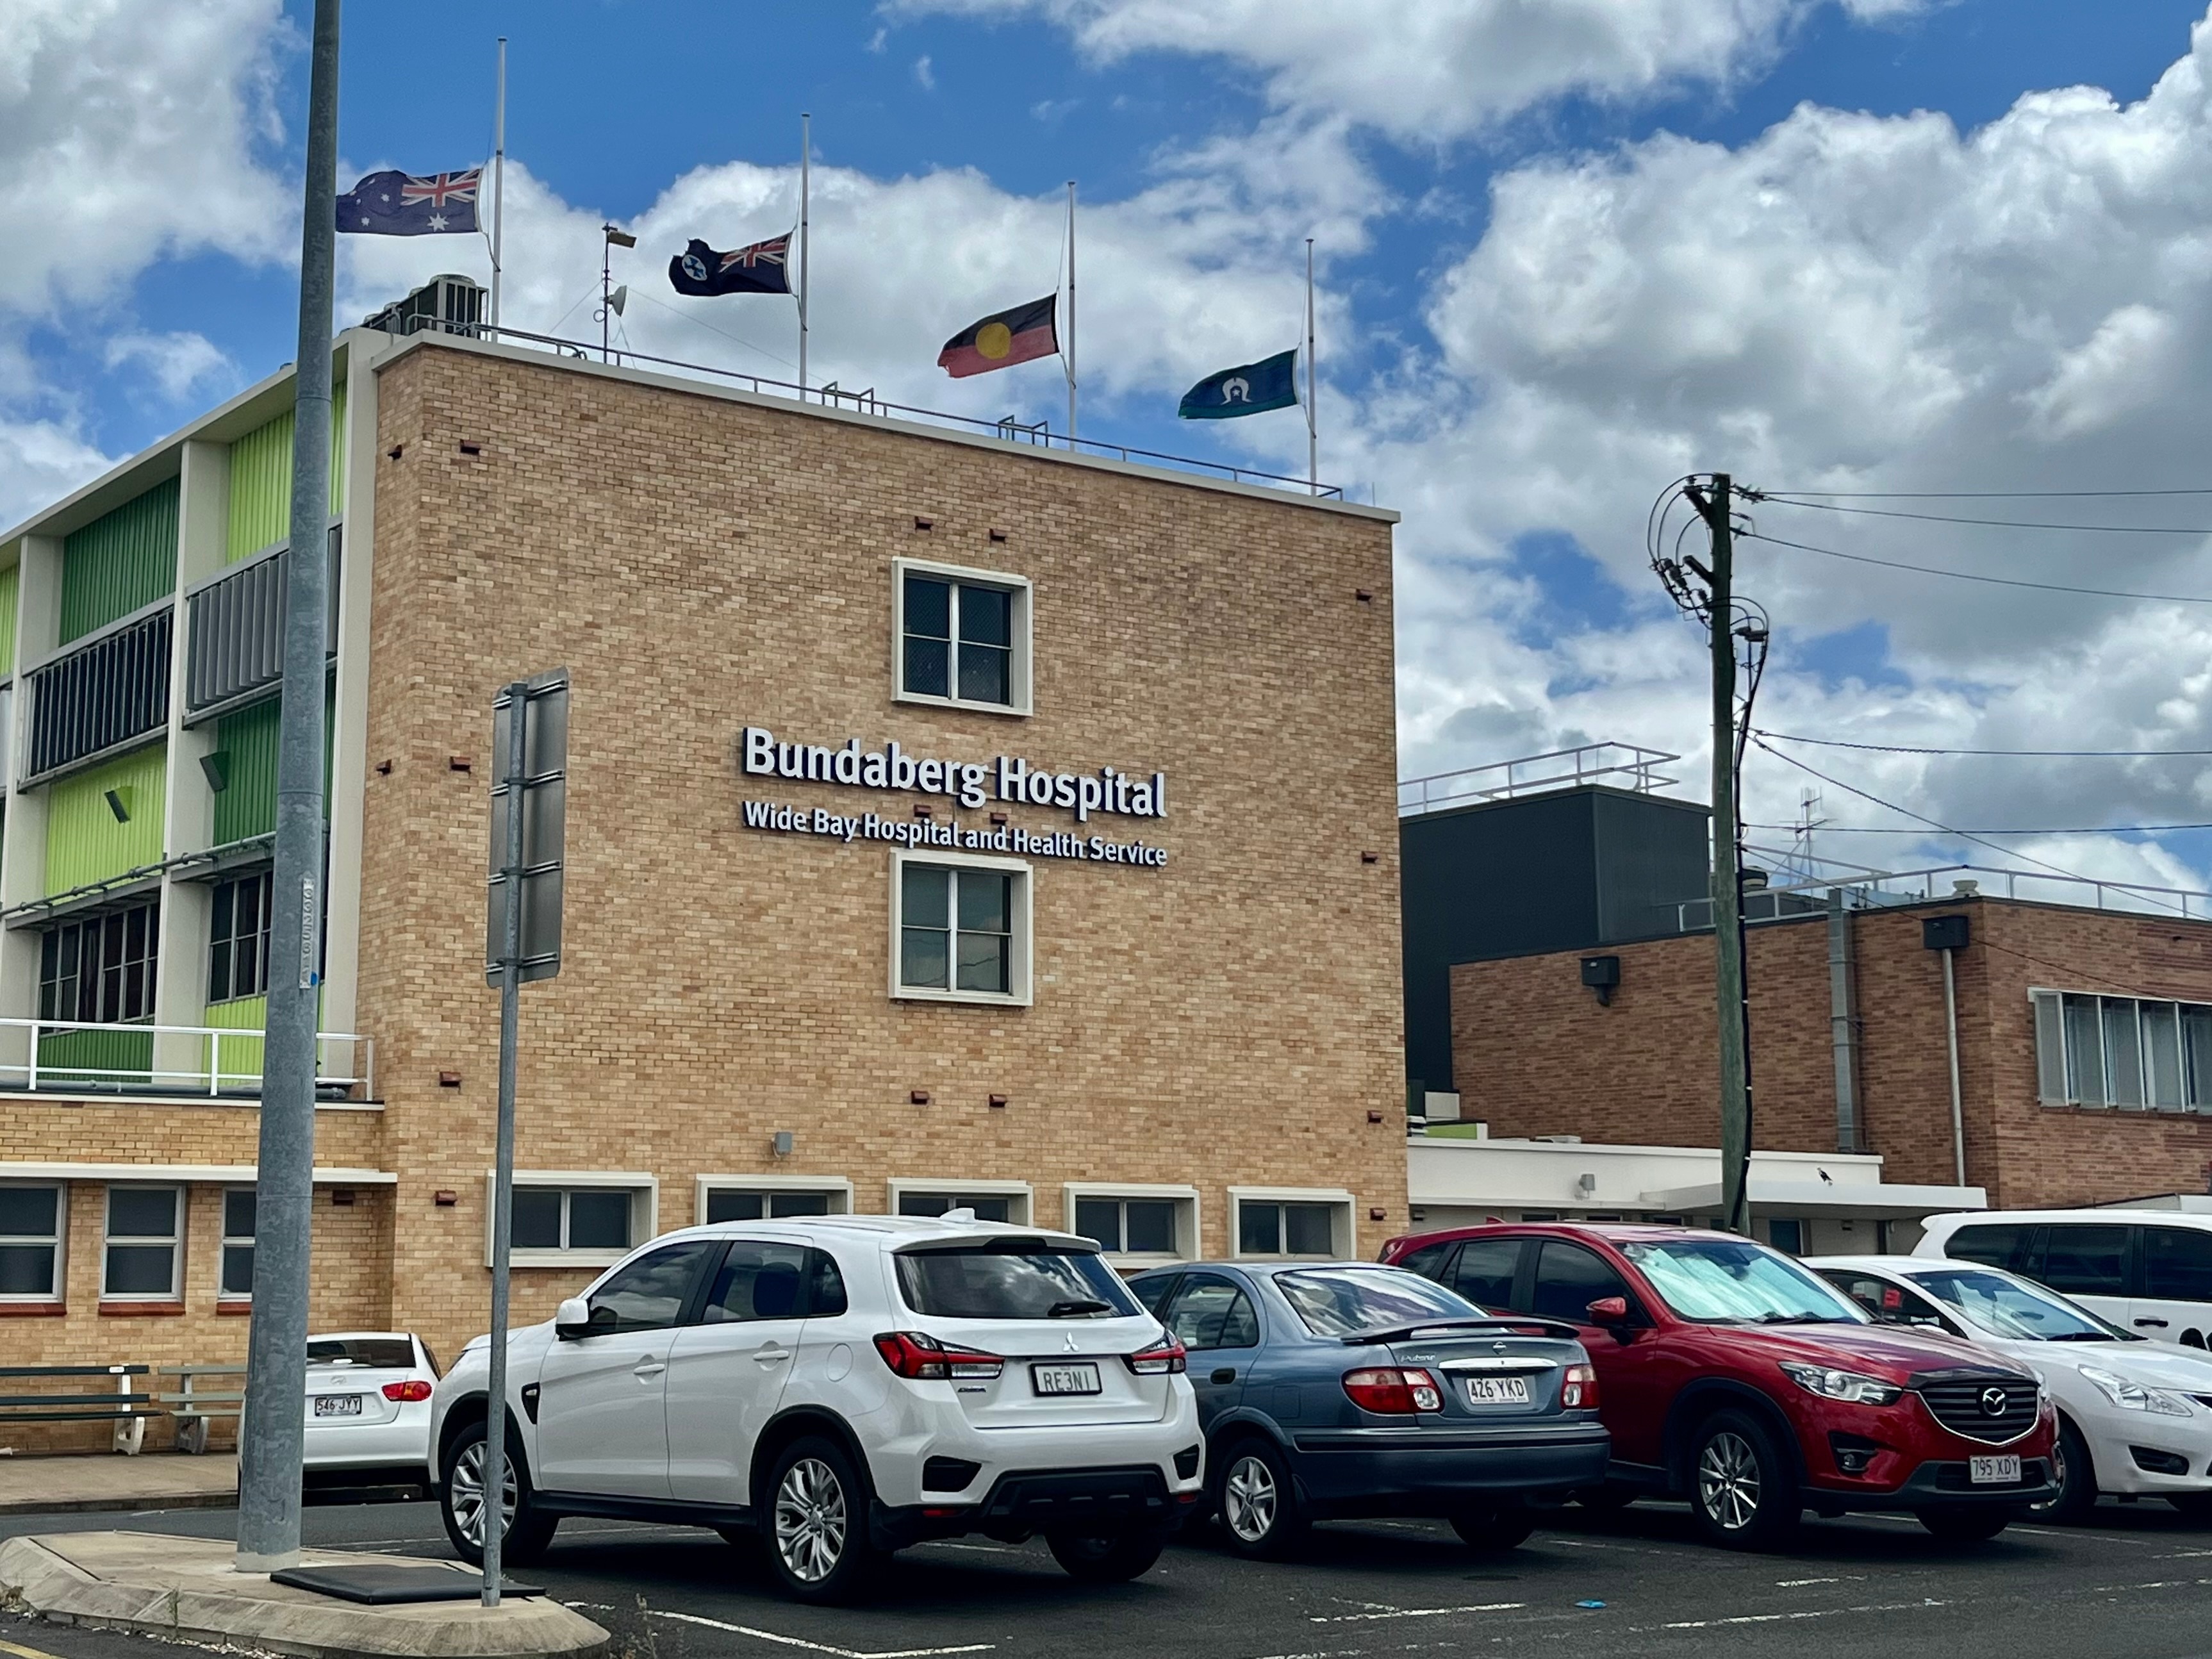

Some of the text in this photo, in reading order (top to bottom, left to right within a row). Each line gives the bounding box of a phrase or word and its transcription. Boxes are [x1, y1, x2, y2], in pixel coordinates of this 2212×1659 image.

[744, 727, 1168, 822] Bundaberg Hospital
[743, 800, 1168, 866] Wide Bay Hospital and Health Service
